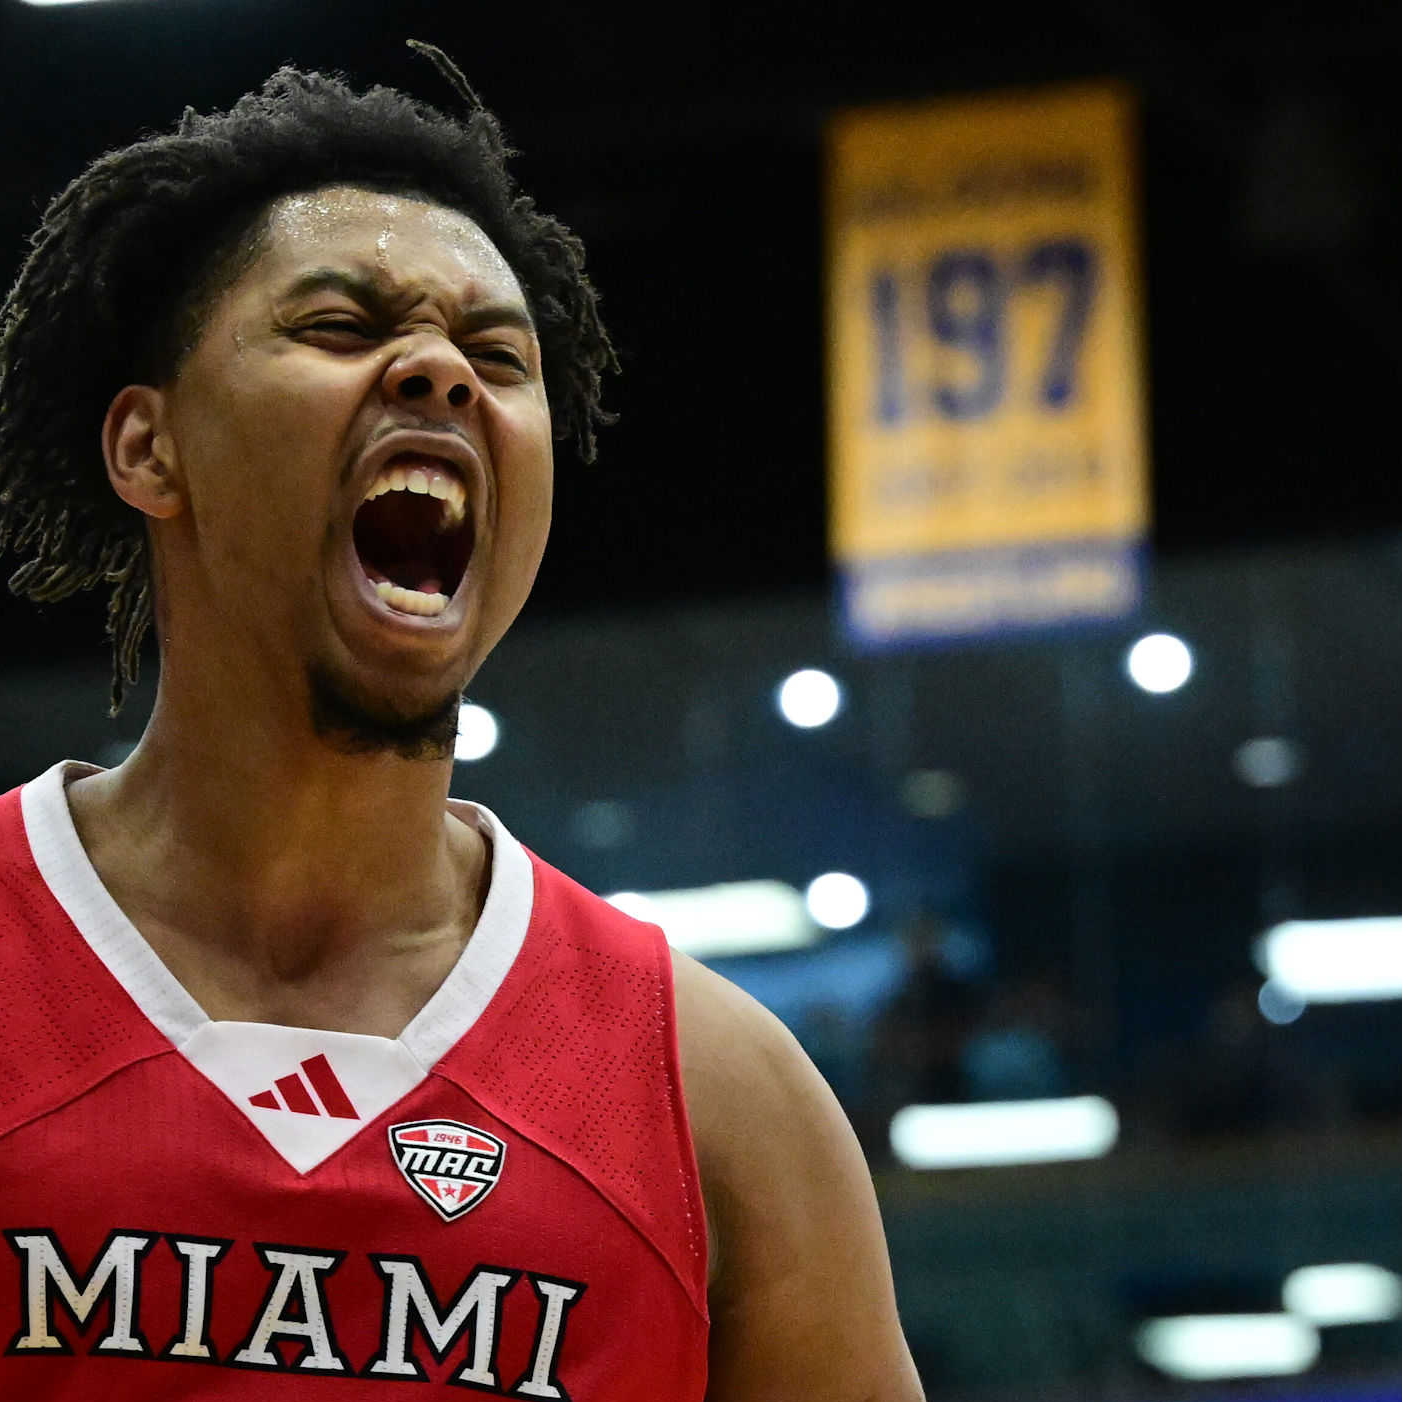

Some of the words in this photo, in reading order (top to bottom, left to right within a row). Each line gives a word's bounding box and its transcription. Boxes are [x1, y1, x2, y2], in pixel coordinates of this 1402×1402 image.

[871, 238, 1096, 426] 197
[433, 1133, 464, 1145] 1946
[399, 1147, 500, 1181] MAC
